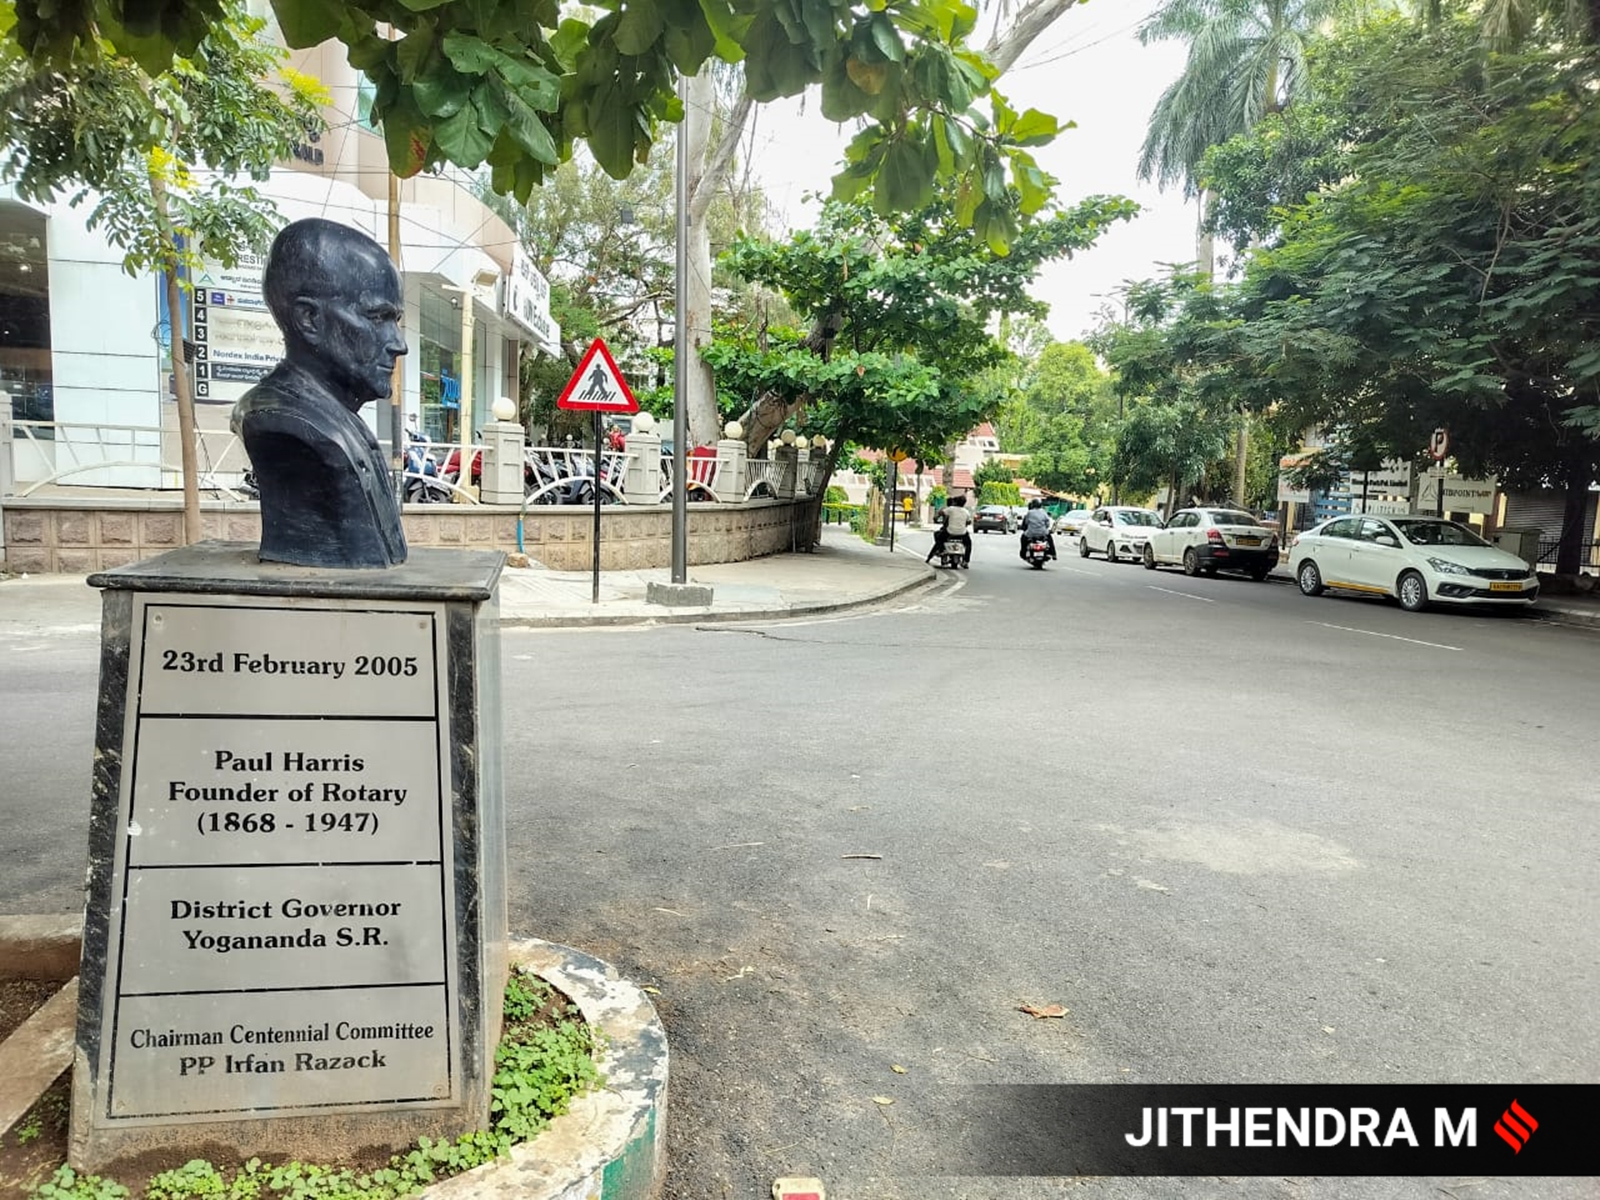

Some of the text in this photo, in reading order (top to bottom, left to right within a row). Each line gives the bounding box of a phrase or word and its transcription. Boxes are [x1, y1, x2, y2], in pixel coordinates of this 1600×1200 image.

[196, 291, 204, 302] 5
[197, 309, 205, 320] 4
[197, 328, 205, 339] 3
[198, 347, 206, 358] 2
[213, 349, 242, 359] Nordex
[244, 352, 264, 361] India
[199, 365, 205, 377] 1
[198, 383, 208, 395] G
[162, 649, 418, 680] 23rd February 2005
[214, 750, 365, 772] Paul Harris
[168, 781, 408, 806] Founder of Rotary
[197, 812, 276, 836] (1868
[305, 812, 379, 836] 1947)
[170, 898, 402, 920] District Governor
[182, 927, 389, 954] Yogananda S.R.
[130, 1021, 434, 1049] Chairman Centennial Committee
[179, 1049, 387, 1076] PP Irfan Razack
